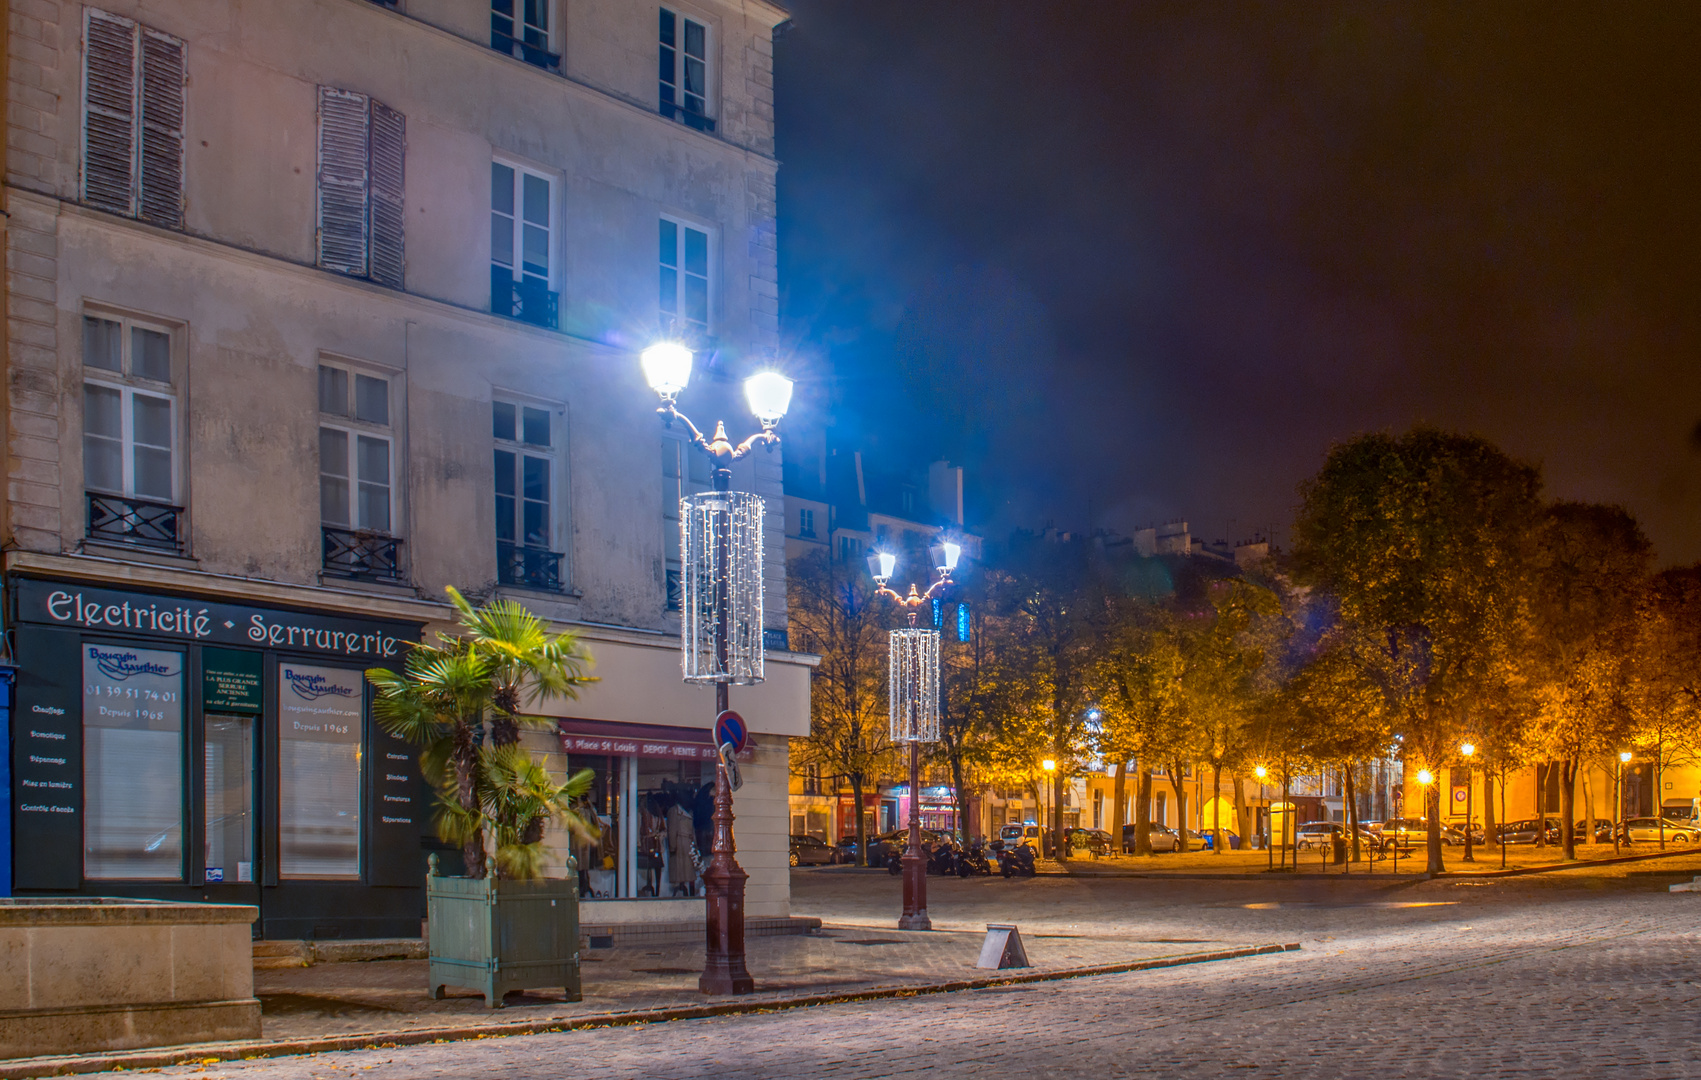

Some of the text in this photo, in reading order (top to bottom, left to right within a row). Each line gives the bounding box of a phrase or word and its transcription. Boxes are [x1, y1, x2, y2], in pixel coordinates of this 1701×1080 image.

[47, 591, 398, 658] Electricité Serrurerie
[119, 660, 170, 674] Gauthier
[232, 678, 260, 686] GRANDE
[309, 683, 354, 695] Gauthier
[86, 684, 176, 703] 01 39 51 74 01
[99, 705, 164, 721] Depuis 1968
[293, 721, 349, 734] Depuis 1968
[575, 739, 599, 751] Place
[601, 741, 612, 752] St
[613, 742, 638, 753] Louis
